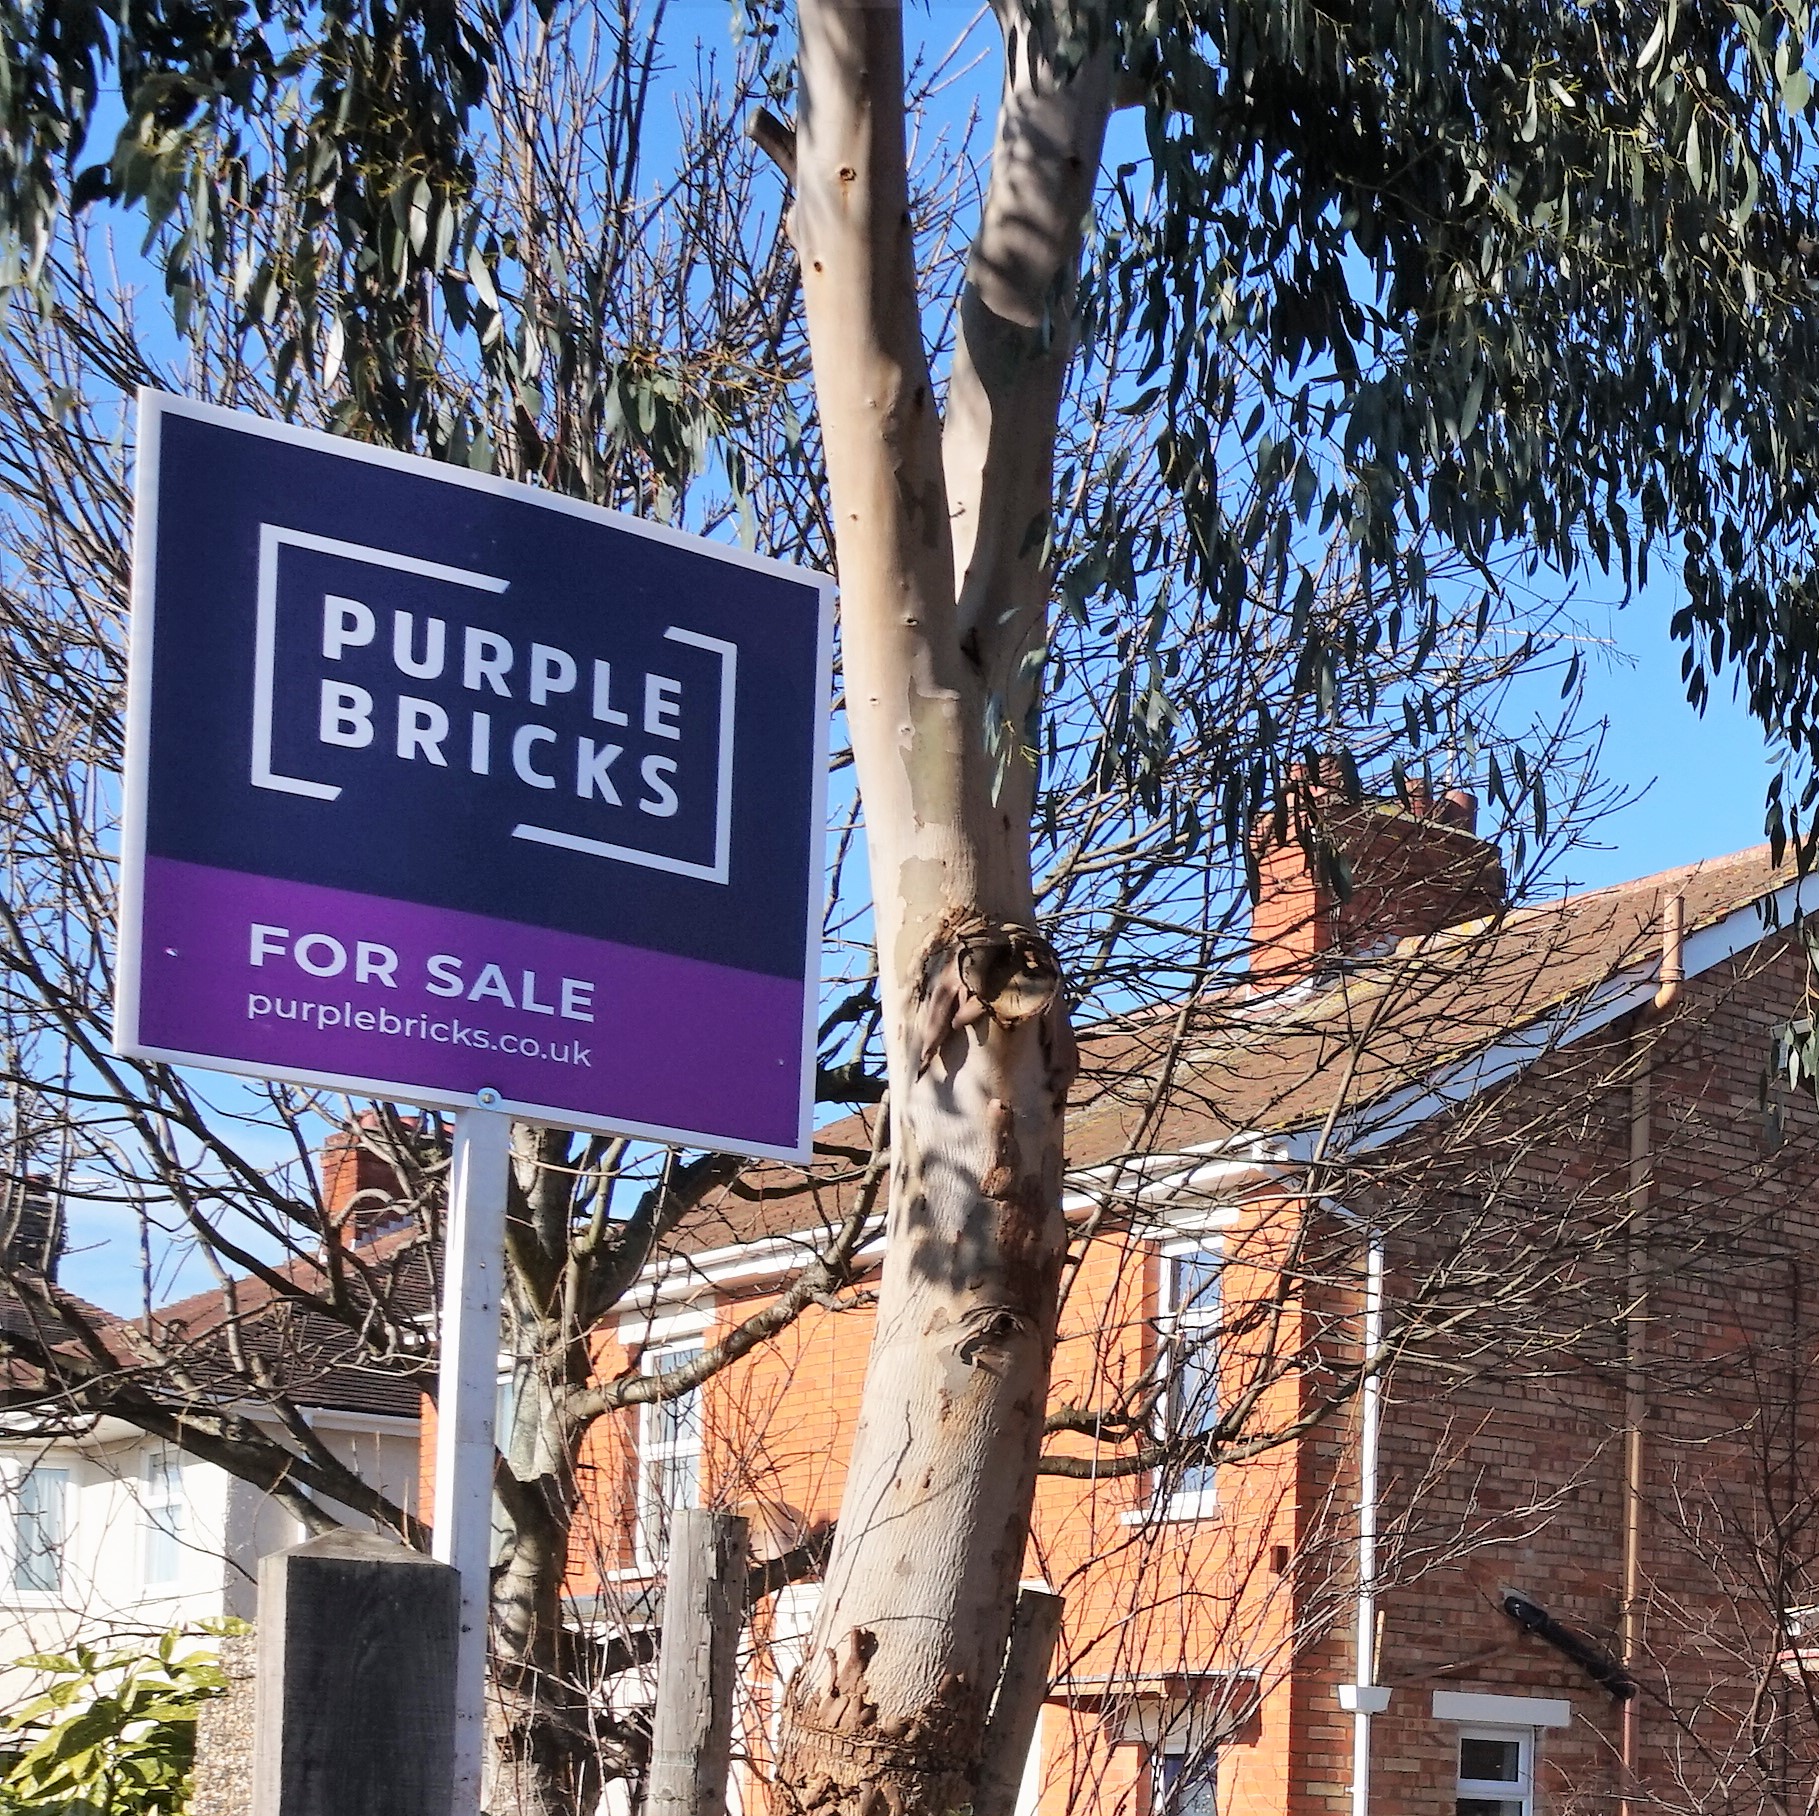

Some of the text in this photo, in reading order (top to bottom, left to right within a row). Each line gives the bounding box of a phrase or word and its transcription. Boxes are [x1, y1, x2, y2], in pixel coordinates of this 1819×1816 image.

[322, 594, 682, 741] PURPLE
[319, 678, 680, 818] BRICKS
[247, 993, 592, 1068] purplebricks.co.uk
[249, 922, 596, 1023] FOR SALE
